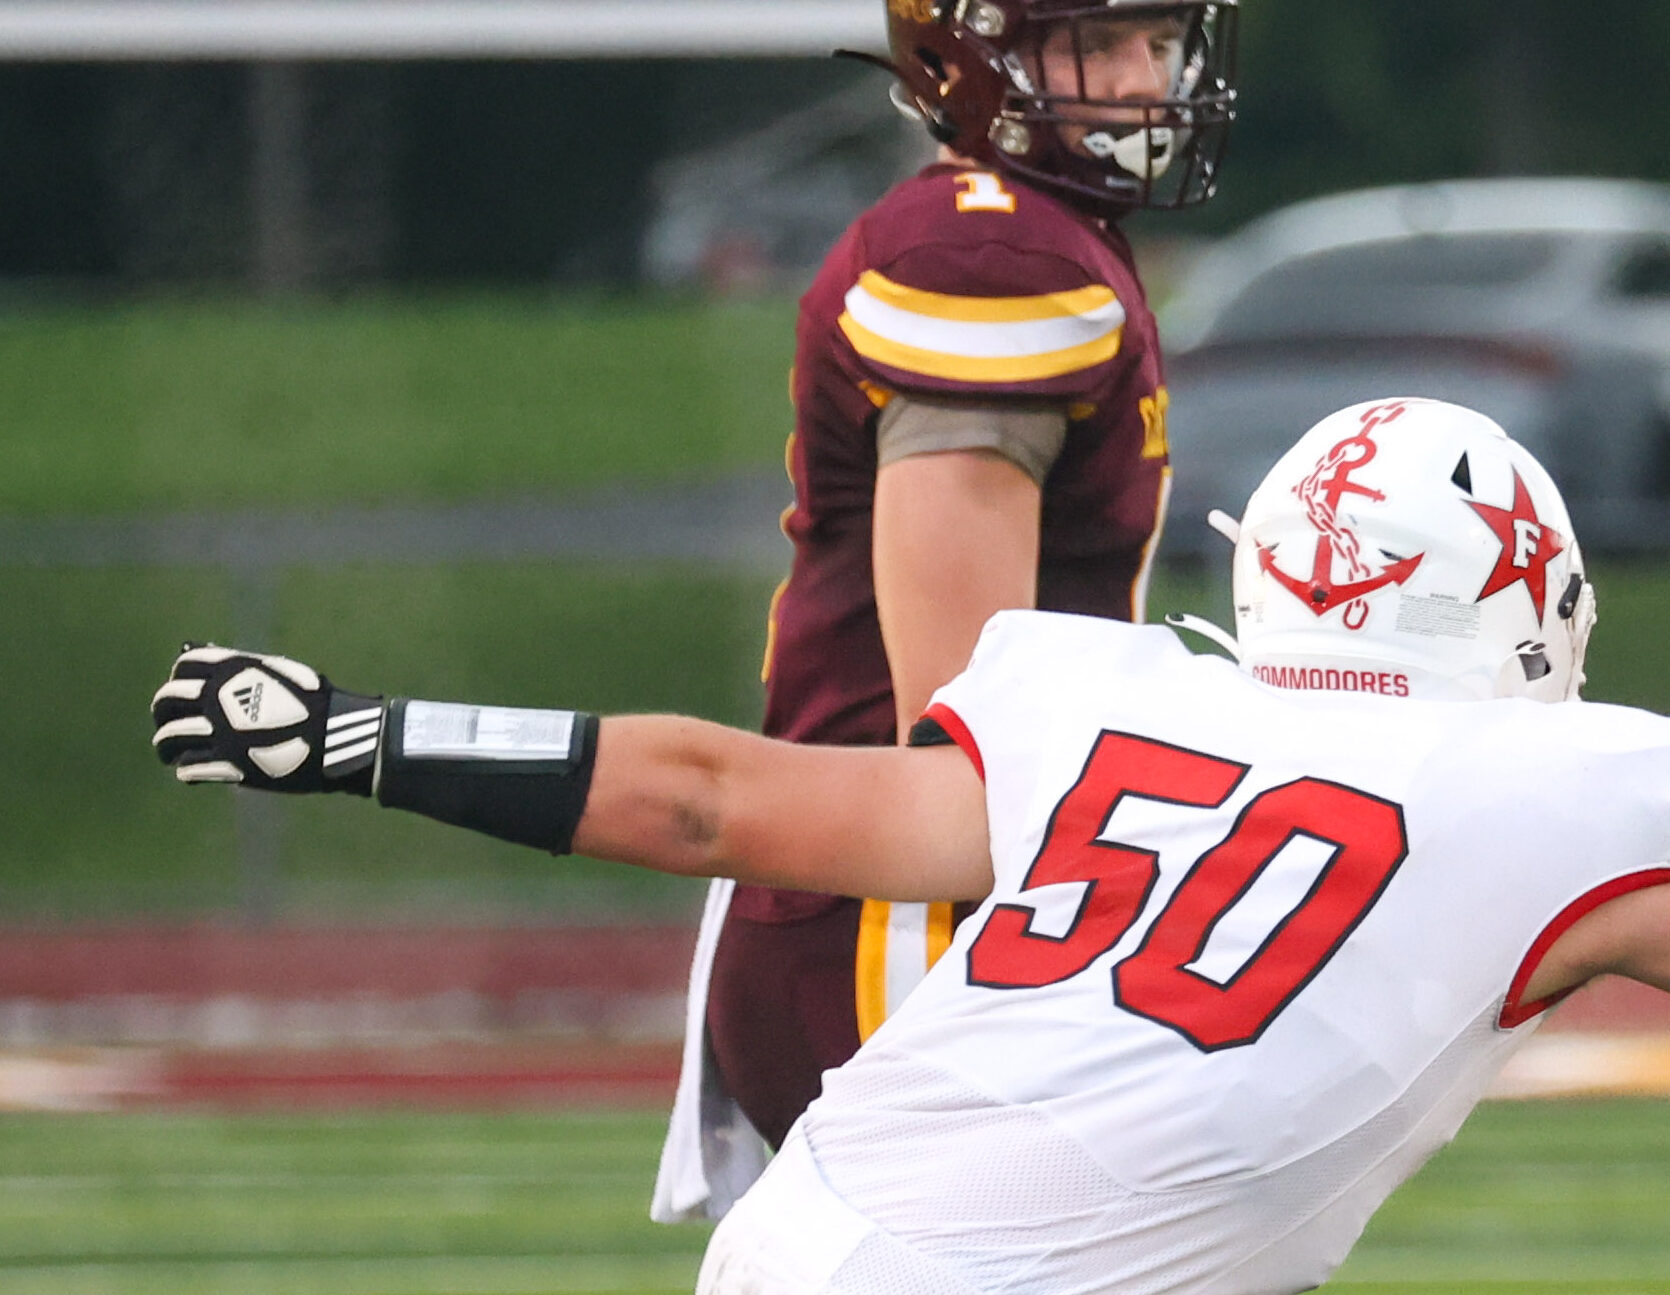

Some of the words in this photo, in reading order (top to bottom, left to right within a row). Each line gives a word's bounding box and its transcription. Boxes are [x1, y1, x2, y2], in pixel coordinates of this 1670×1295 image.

[953, 172, 1017, 214] 1
[1511, 518, 1542, 569] F
[1252, 666, 1410, 698] COMMODORES
[966, 728, 1409, 1054] 50
